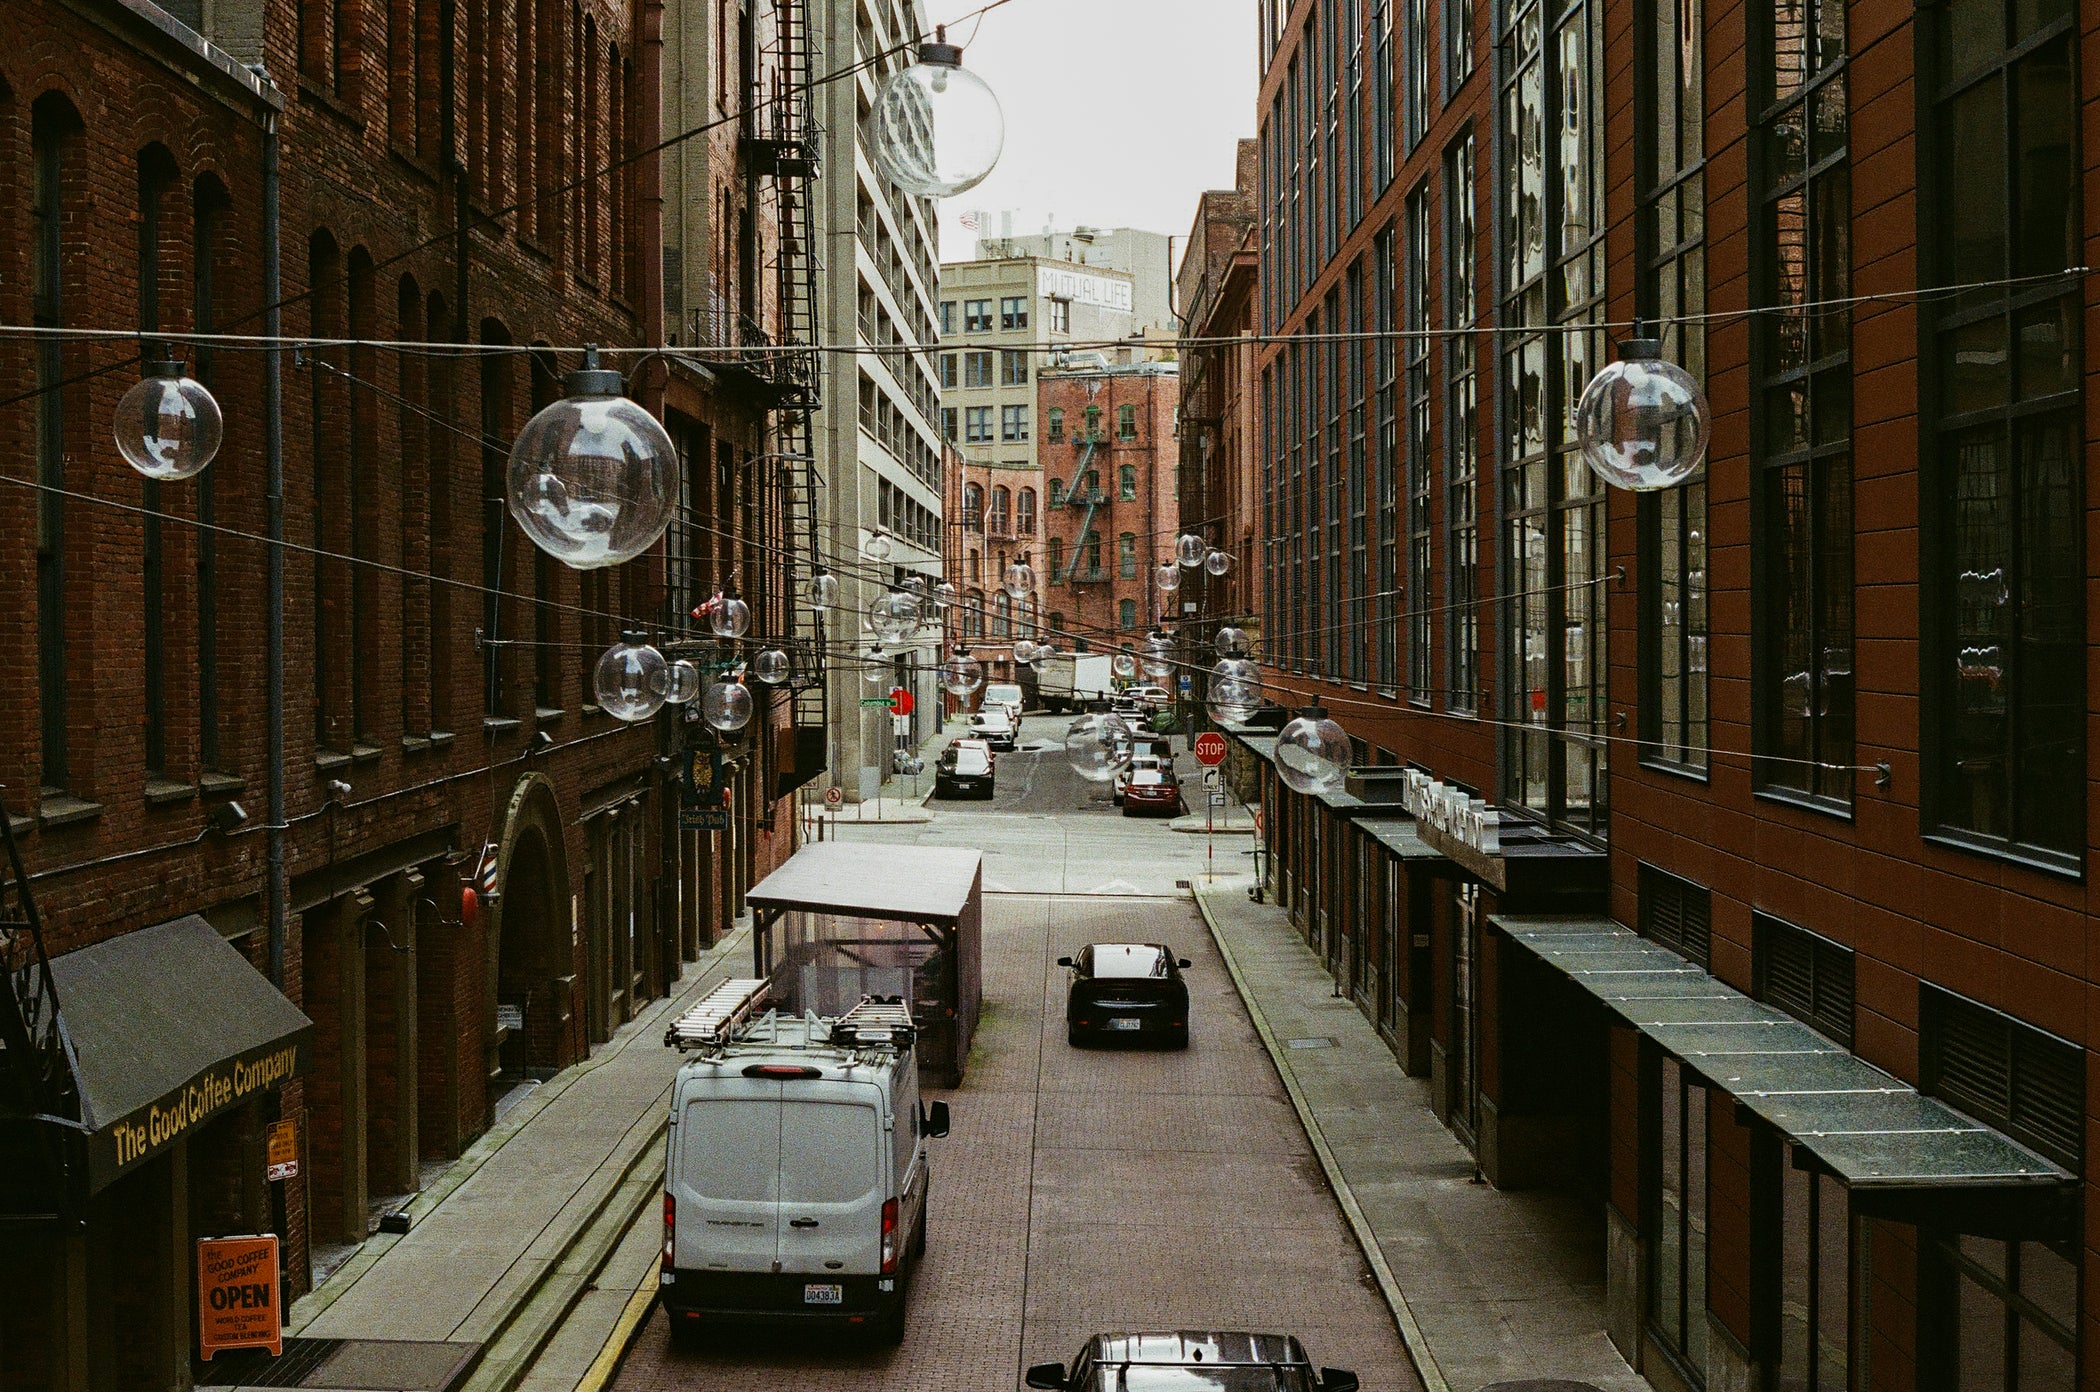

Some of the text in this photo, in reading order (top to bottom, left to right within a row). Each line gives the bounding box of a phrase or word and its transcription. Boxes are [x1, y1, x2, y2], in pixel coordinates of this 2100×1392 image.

[1042, 271, 1128, 306] MUTUAL LIFE
[1197, 742, 1225, 756] STOP
[113, 1044, 297, 1167] The Good Coffee Company
[207, 1247, 270, 1274] GOOD COFFEE
[217, 1263, 260, 1283] COMPANY
[210, 1284, 269, 1310] OPEN
